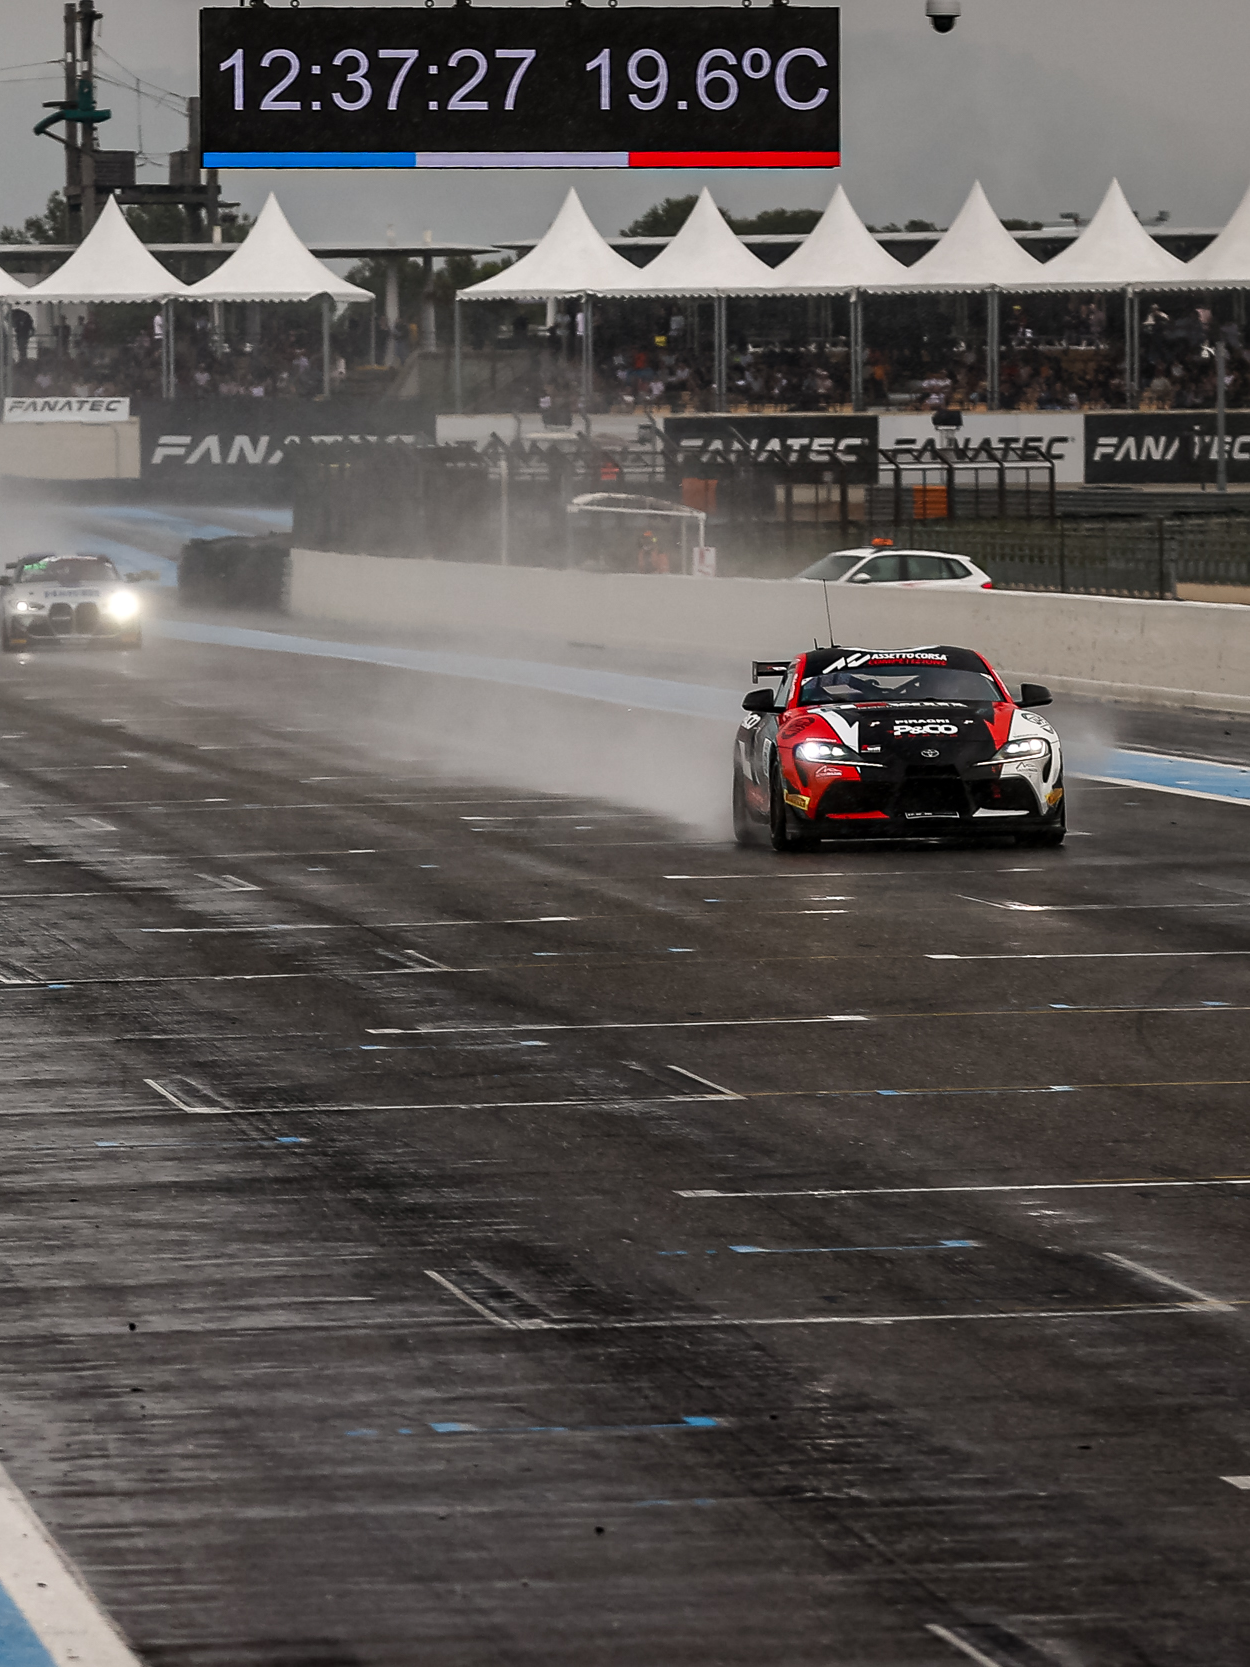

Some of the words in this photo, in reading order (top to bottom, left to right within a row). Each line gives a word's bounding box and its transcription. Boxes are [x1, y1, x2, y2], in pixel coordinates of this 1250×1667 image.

[218, 48, 537, 111] 12:37:27
[9, 400, 121, 412] FANATEC
[676, 437, 863, 464] FANATEC
[892, 436, 1070, 461] FANATEC
[871, 652, 915, 660] ASSETTO
[915, 653, 948, 662] CORSA
